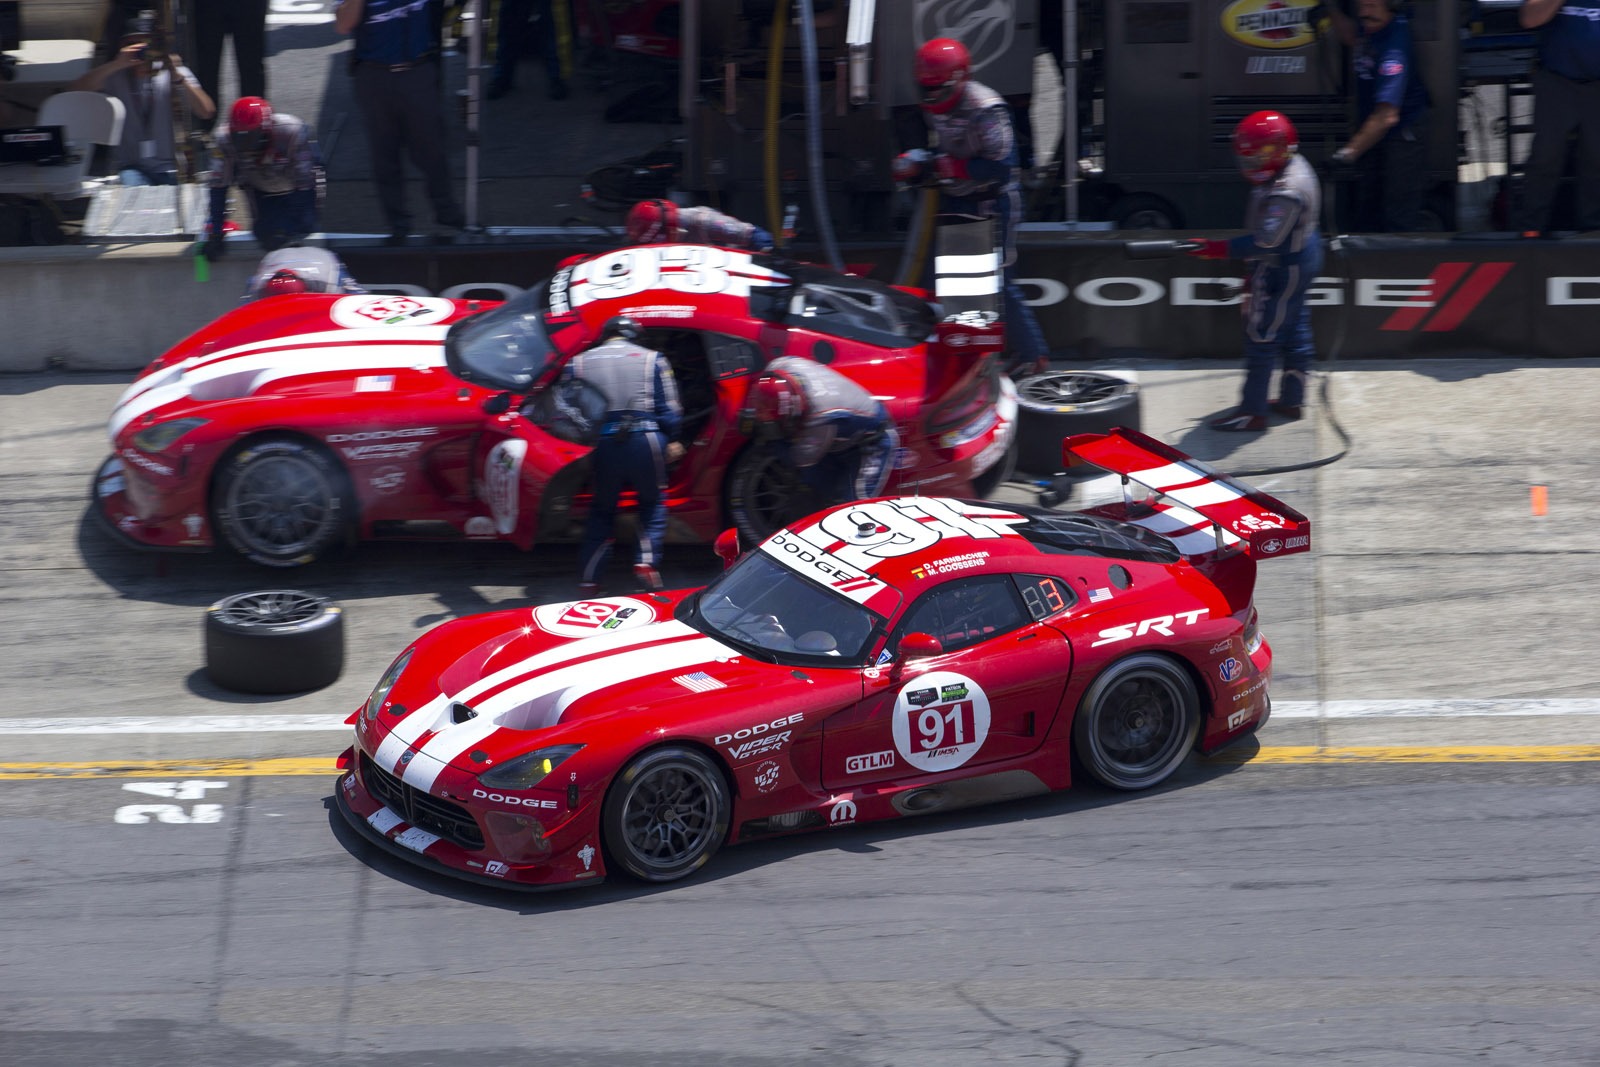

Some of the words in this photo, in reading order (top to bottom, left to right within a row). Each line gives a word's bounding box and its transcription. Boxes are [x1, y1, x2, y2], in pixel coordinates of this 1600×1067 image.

[1235, 6, 1308, 32] PENNZ
[326, 427, 438, 442] DODGE
[771, 534, 854, 584] DODGE
[934, 551, 990, 567] FARNBACHER
[938, 558, 986, 574] GOOSSENS
[562, 601, 615, 625] 91
[1091, 607, 1210, 648] SRT
[714, 712, 804, 745] DODGE
[918, 703, 964, 749] 91
[727, 729, 792, 759] VIPER
[738, 742, 783, 760] GTS-R
[847, 751, 893, 771] GTLM
[472, 788, 558, 809] DODGE
